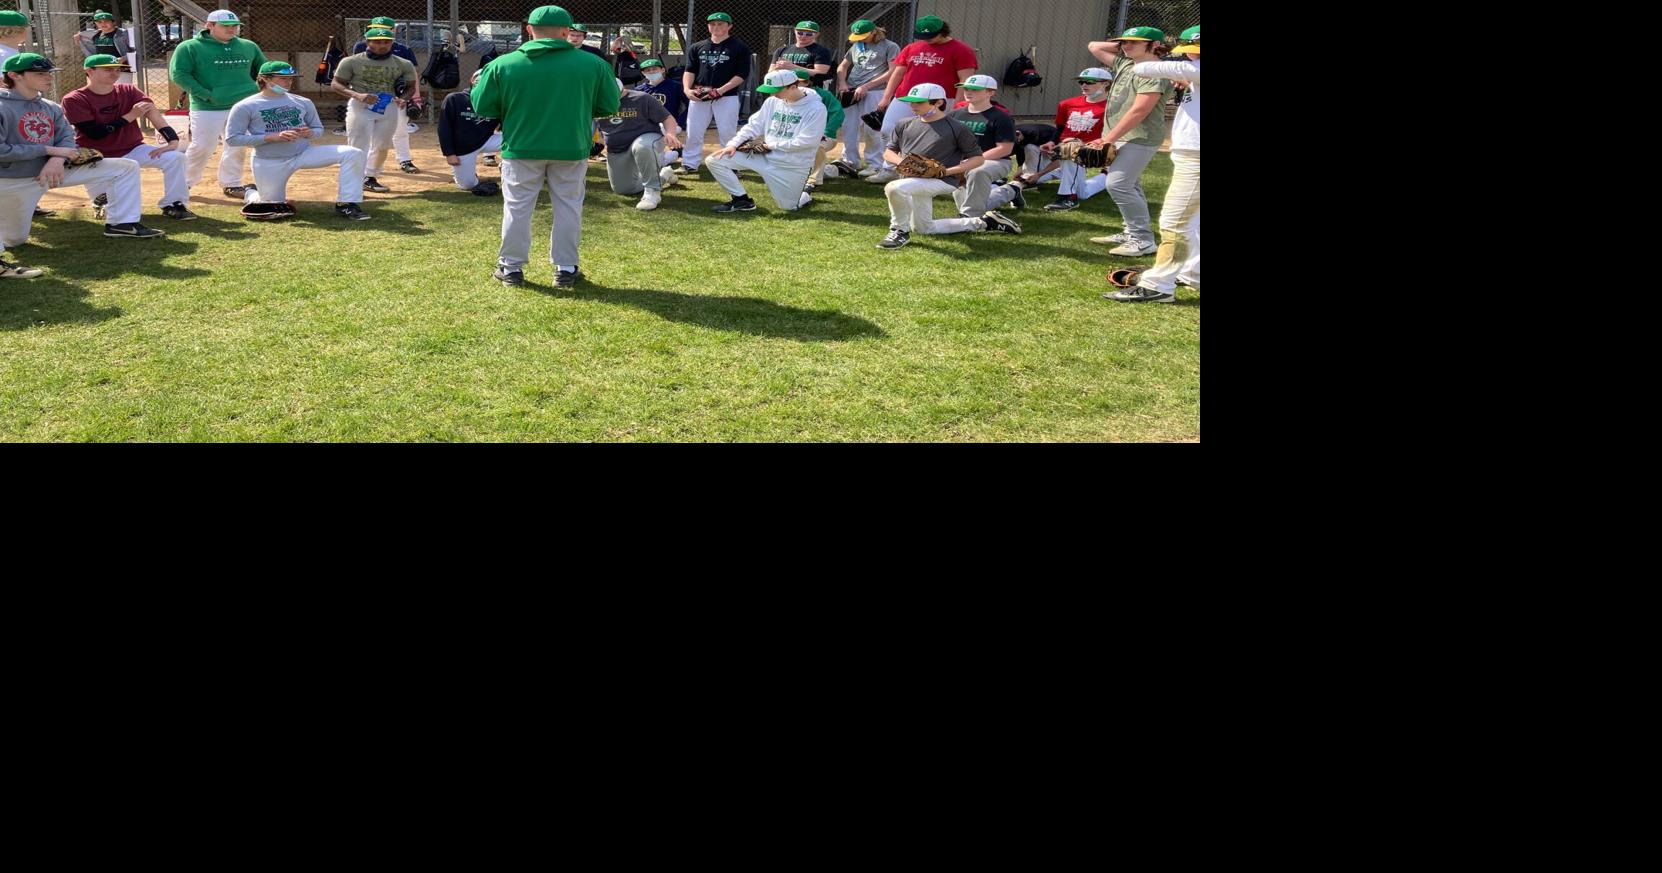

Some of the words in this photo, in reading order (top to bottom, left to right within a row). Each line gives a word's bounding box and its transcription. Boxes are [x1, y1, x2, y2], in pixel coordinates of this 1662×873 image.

[766, 78, 773, 86] R
[910, 88, 919, 96] R
[609, 117, 624, 125] G
